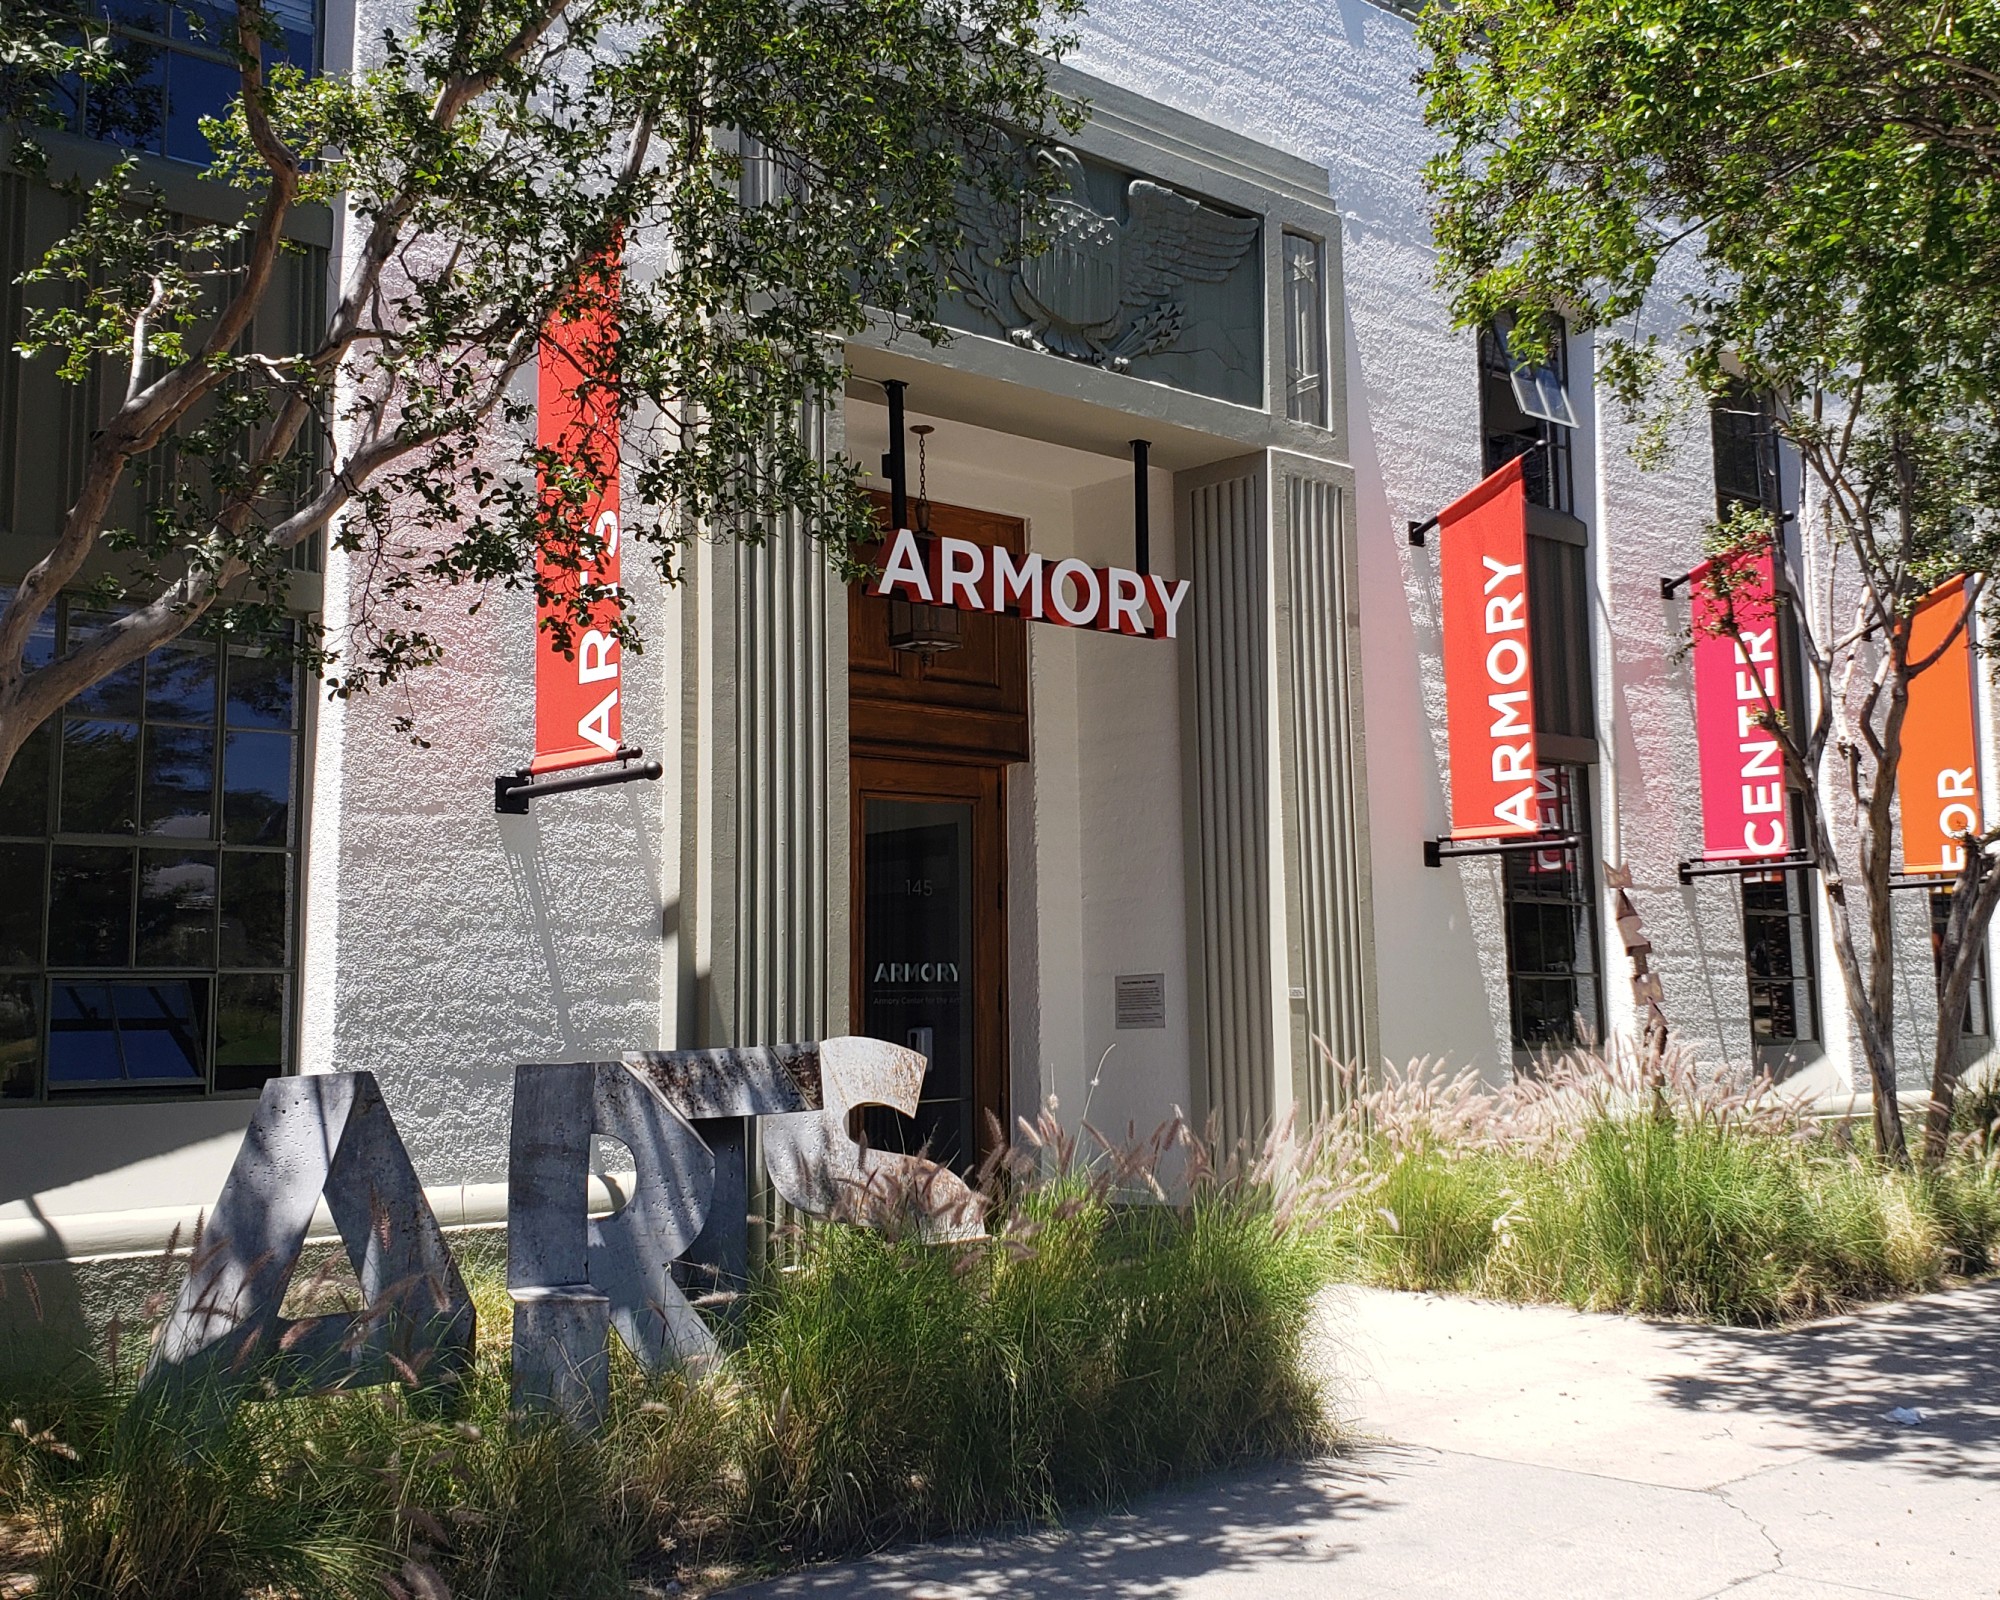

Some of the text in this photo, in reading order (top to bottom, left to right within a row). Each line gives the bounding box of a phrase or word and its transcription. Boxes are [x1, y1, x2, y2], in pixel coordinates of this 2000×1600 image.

[878, 528, 1190, 638] ARMORY
[1482, 556, 1538, 832] ARMORY
[1734, 627, 1784, 855] CENTER
[874, 962, 960, 982] ARMORY
[905, 879, 933, 897] 145
[132, 1036, 992, 1422] ARTS
